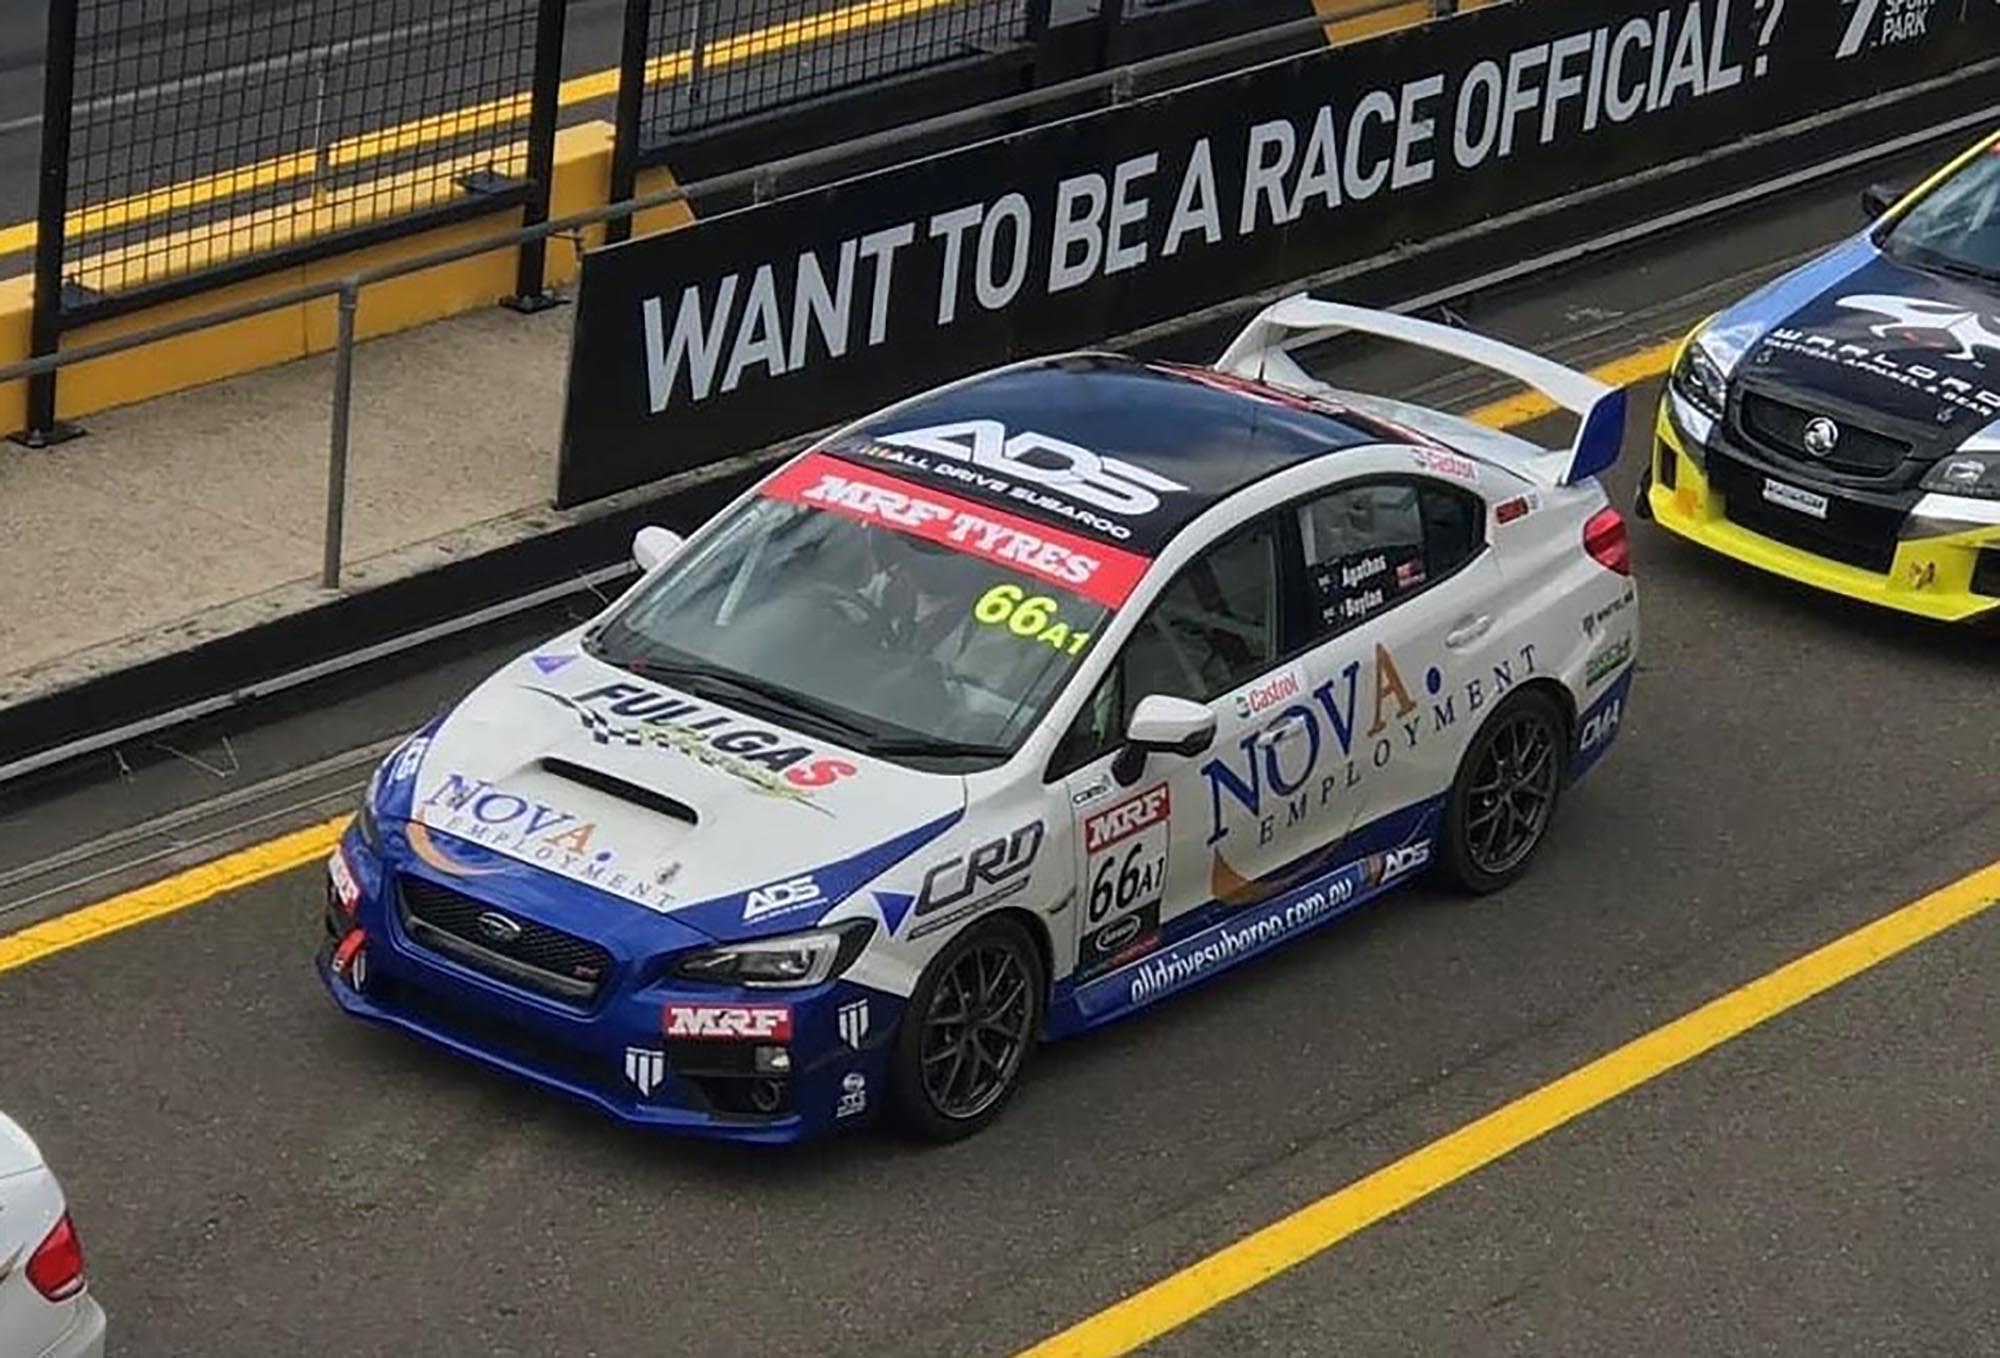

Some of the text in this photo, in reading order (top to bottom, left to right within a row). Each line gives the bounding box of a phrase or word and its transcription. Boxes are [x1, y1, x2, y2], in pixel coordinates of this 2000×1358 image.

[1880, 8, 1927, 45] PARK
[643, 223, 915, 413] WANT
[930, 192, 1032, 325] TO
[1049, 152, 1159, 294] BE
[1161, 138, 1222, 257] A
[1239, 74, 1445, 235] RACE
[873, 418, 1192, 517] ADS
[888, 451, 1131, 540] ALL DRIVE SUBAROO
[803, 475, 1101, 584] MRF TYRES
[1250, 673, 1300, 714] Castrol
[1201, 643, 1417, 846] NOVA
[1257, 644, 1537, 847] EMPLOYMENT
[424, 774, 596, 856] NOVA
[1089, 787, 1166, 849] MRF
[446, 814, 677, 907] EMPLOYMENT
[743, 876, 820, 920] ADS
[914, 819, 1045, 917] CRD
[1380, 838, 1433, 884] ADS
[667, 1007, 789, 1037] MRF
